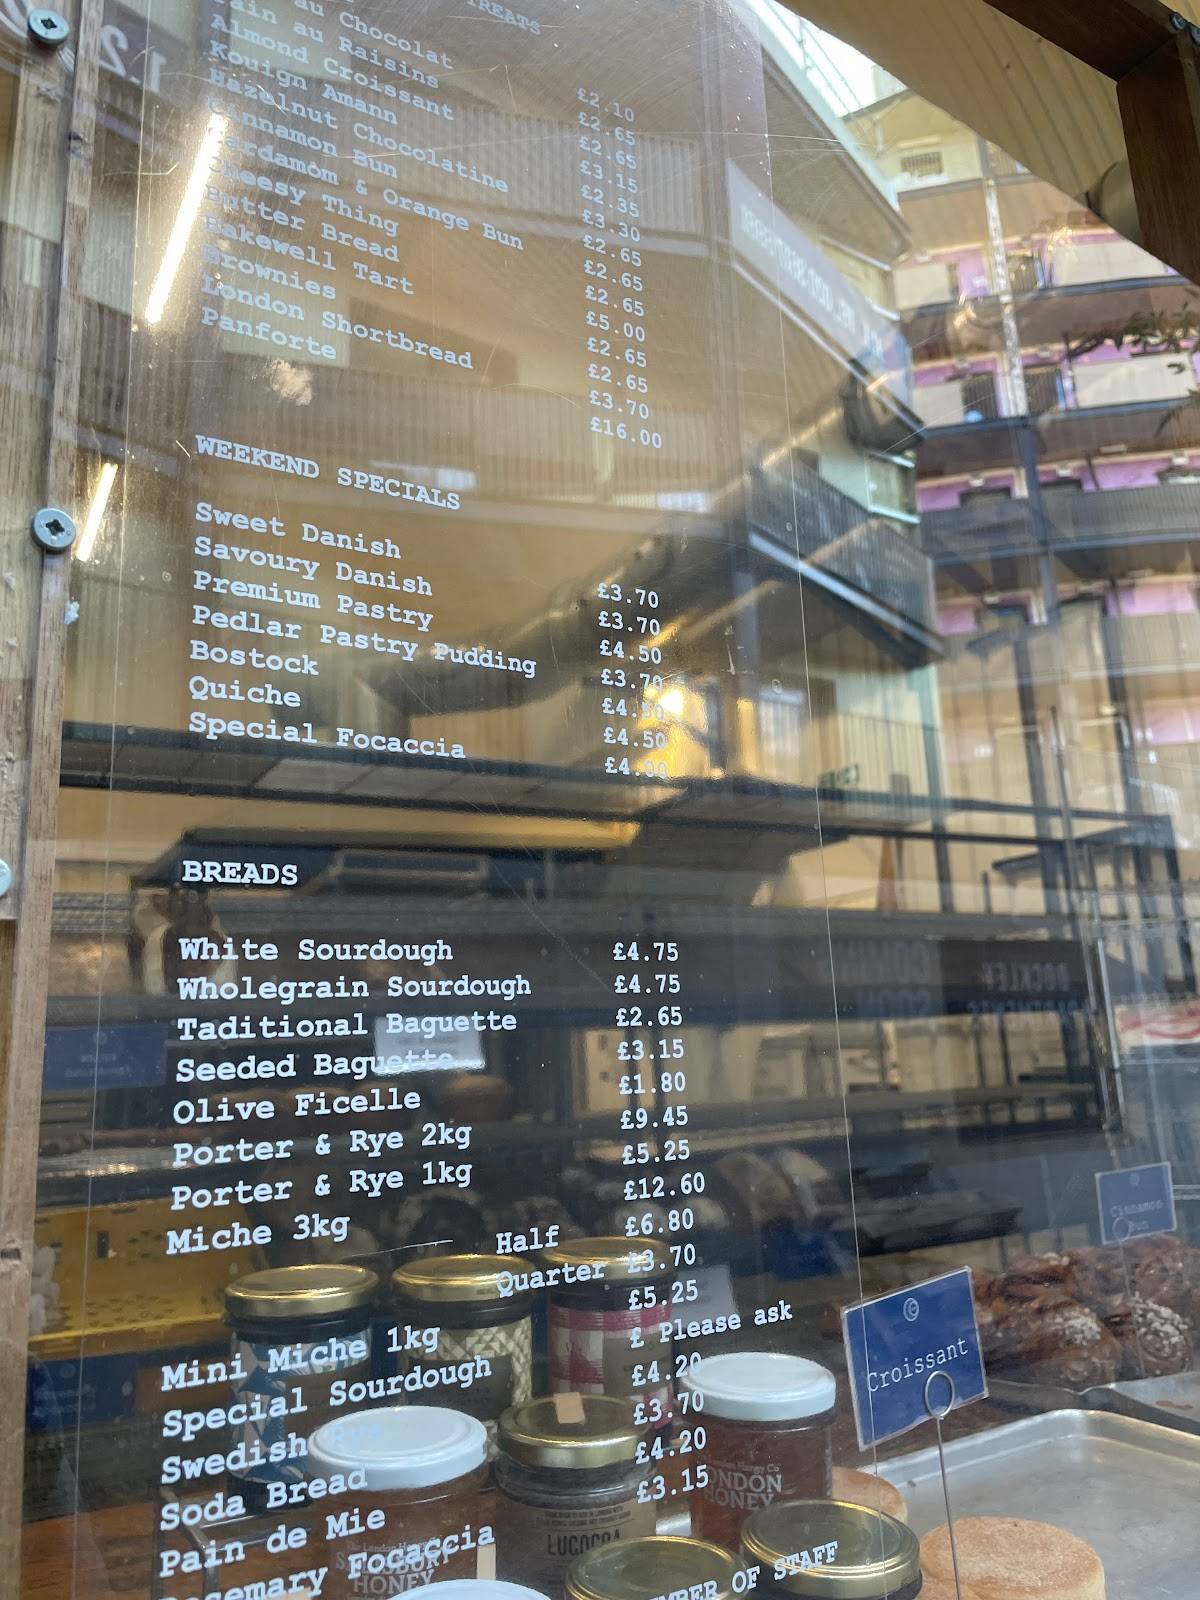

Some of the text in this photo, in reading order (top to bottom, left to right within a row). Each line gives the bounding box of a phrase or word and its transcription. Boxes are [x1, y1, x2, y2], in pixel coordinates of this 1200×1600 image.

[218, 0, 439, 89] ain au Raisins
[340, 11, 454, 70] Chocolat
[209, 14, 454, 120] Almond Croissant
[209, 39, 398, 125] Kouign Amann
[576, 87, 634, 122] £2.10
[207, 96, 398, 179] Cinnamon Bun
[208, 68, 509, 193] Hazelnut Chocolatine
[577, 111, 636, 146] £2.65
[578, 135, 637, 169] £2.65
[579, 159, 638, 193] £3.15
[322, 193, 399, 238] Thing
[355, 179, 368, 196] &
[383, 189, 469, 231] Orange
[482, 223, 524, 250] Bun
[580, 184, 640, 218] £2.35
[206, 184, 400, 263] Butter Bread
[581, 209, 640, 242] £3.30
[204, 215, 414, 295] Bakewell Tart
[583, 234, 642, 267] £2.65
[202, 244, 336, 300] Brownies
[583, 259, 643, 292] £2.65
[584, 285, 645, 317] £2.65
[201, 272, 473, 370] London Shortbread
[201, 306, 337, 360] Panforte
[586, 311, 646, 342] £5.00
[586, 336, 647, 368] £2.65
[588, 363, 648, 394] £2.65
[589, 389, 649, 419] £3.70
[590, 416, 662, 449] £16.00
[194, 434, 461, 511] WEEKEND SPECIALS
[195, 502, 402, 560] Sweet Danish
[194, 536, 433, 598] Savoury Danish
[193, 569, 434, 633] Premium Pastry
[597, 582, 659, 609] £3.70
[598, 610, 661, 636] £3.70
[190, 639, 319, 677] Bostock
[192, 604, 537, 680] Pedlar Pastry Pudding
[599, 639, 662, 665] £4.50
[188, 675, 301, 708] Quiche
[600, 668, 663, 693] £3.70
[188, 711, 466, 760] Special Focaccia
[603, 726, 667, 750] £4.50
[181, 860, 299, 886] BREADS
[178, 937, 454, 967] White Sourdough
[612, 942, 679, 962] £4.75
[176, 974, 532, 1006] Wholegrain Sourdough
[614, 974, 681, 994] £4.75
[176, 1010, 518, 1042] Taditional Baguette
[615, 1006, 683, 1027] £2.65
[617, 1038, 684, 1061] £3.15
[175, 1055, 297, 1084] Seeded
[618, 1071, 686, 1095] £1.80
[173, 1087, 421, 1125] Olive Ficelle
[620, 1105, 688, 1130] £9.45
[172, 1122, 473, 1168] Porter & Rye 2kg
[622, 1139, 690, 1165] £5.25
[170, 1161, 473, 1211] Porter & Rye 1kg
[623, 1172, 706, 1201] £12.60
[166, 1213, 351, 1256] Miche 3kg
[496, 1225, 560, 1255] Half
[625, 1207, 695, 1238] £6.80
[627, 1242, 696, 1275] £3.70
[495, 1260, 605, 1298] Quarter
[628, 1279, 699, 1312] £5.25
[630, 1300, 793, 1349] £ Please ask
[160, 1324, 441, 1392] Mini Miche 1kg
[631, 1351, 703, 1387] £4.20
[867, 1337, 968, 1393] Croissant
[162, 1387, 308, 1443] Special
[329, 1355, 493, 1407] Sourdough
[633, 1390, 705, 1426] £3.70
[161, 1432, 309, 1485] Swedish
[635, 1426, 707, 1466] £4.20
[636, 1464, 709, 1504] £3.15
[706, 1465, 782, 1494] ONDON
[160, 1467, 368, 1531] Soda Bread
[159, 1507, 386, 1578] Pain de Mie
[158, 1524, 495, 1600] semary Focaccia
[731, 1565, 760, 1594] OF
[774, 1540, 838, 1581] STAFF
[352, 1568, 435, 1595] HONEY
